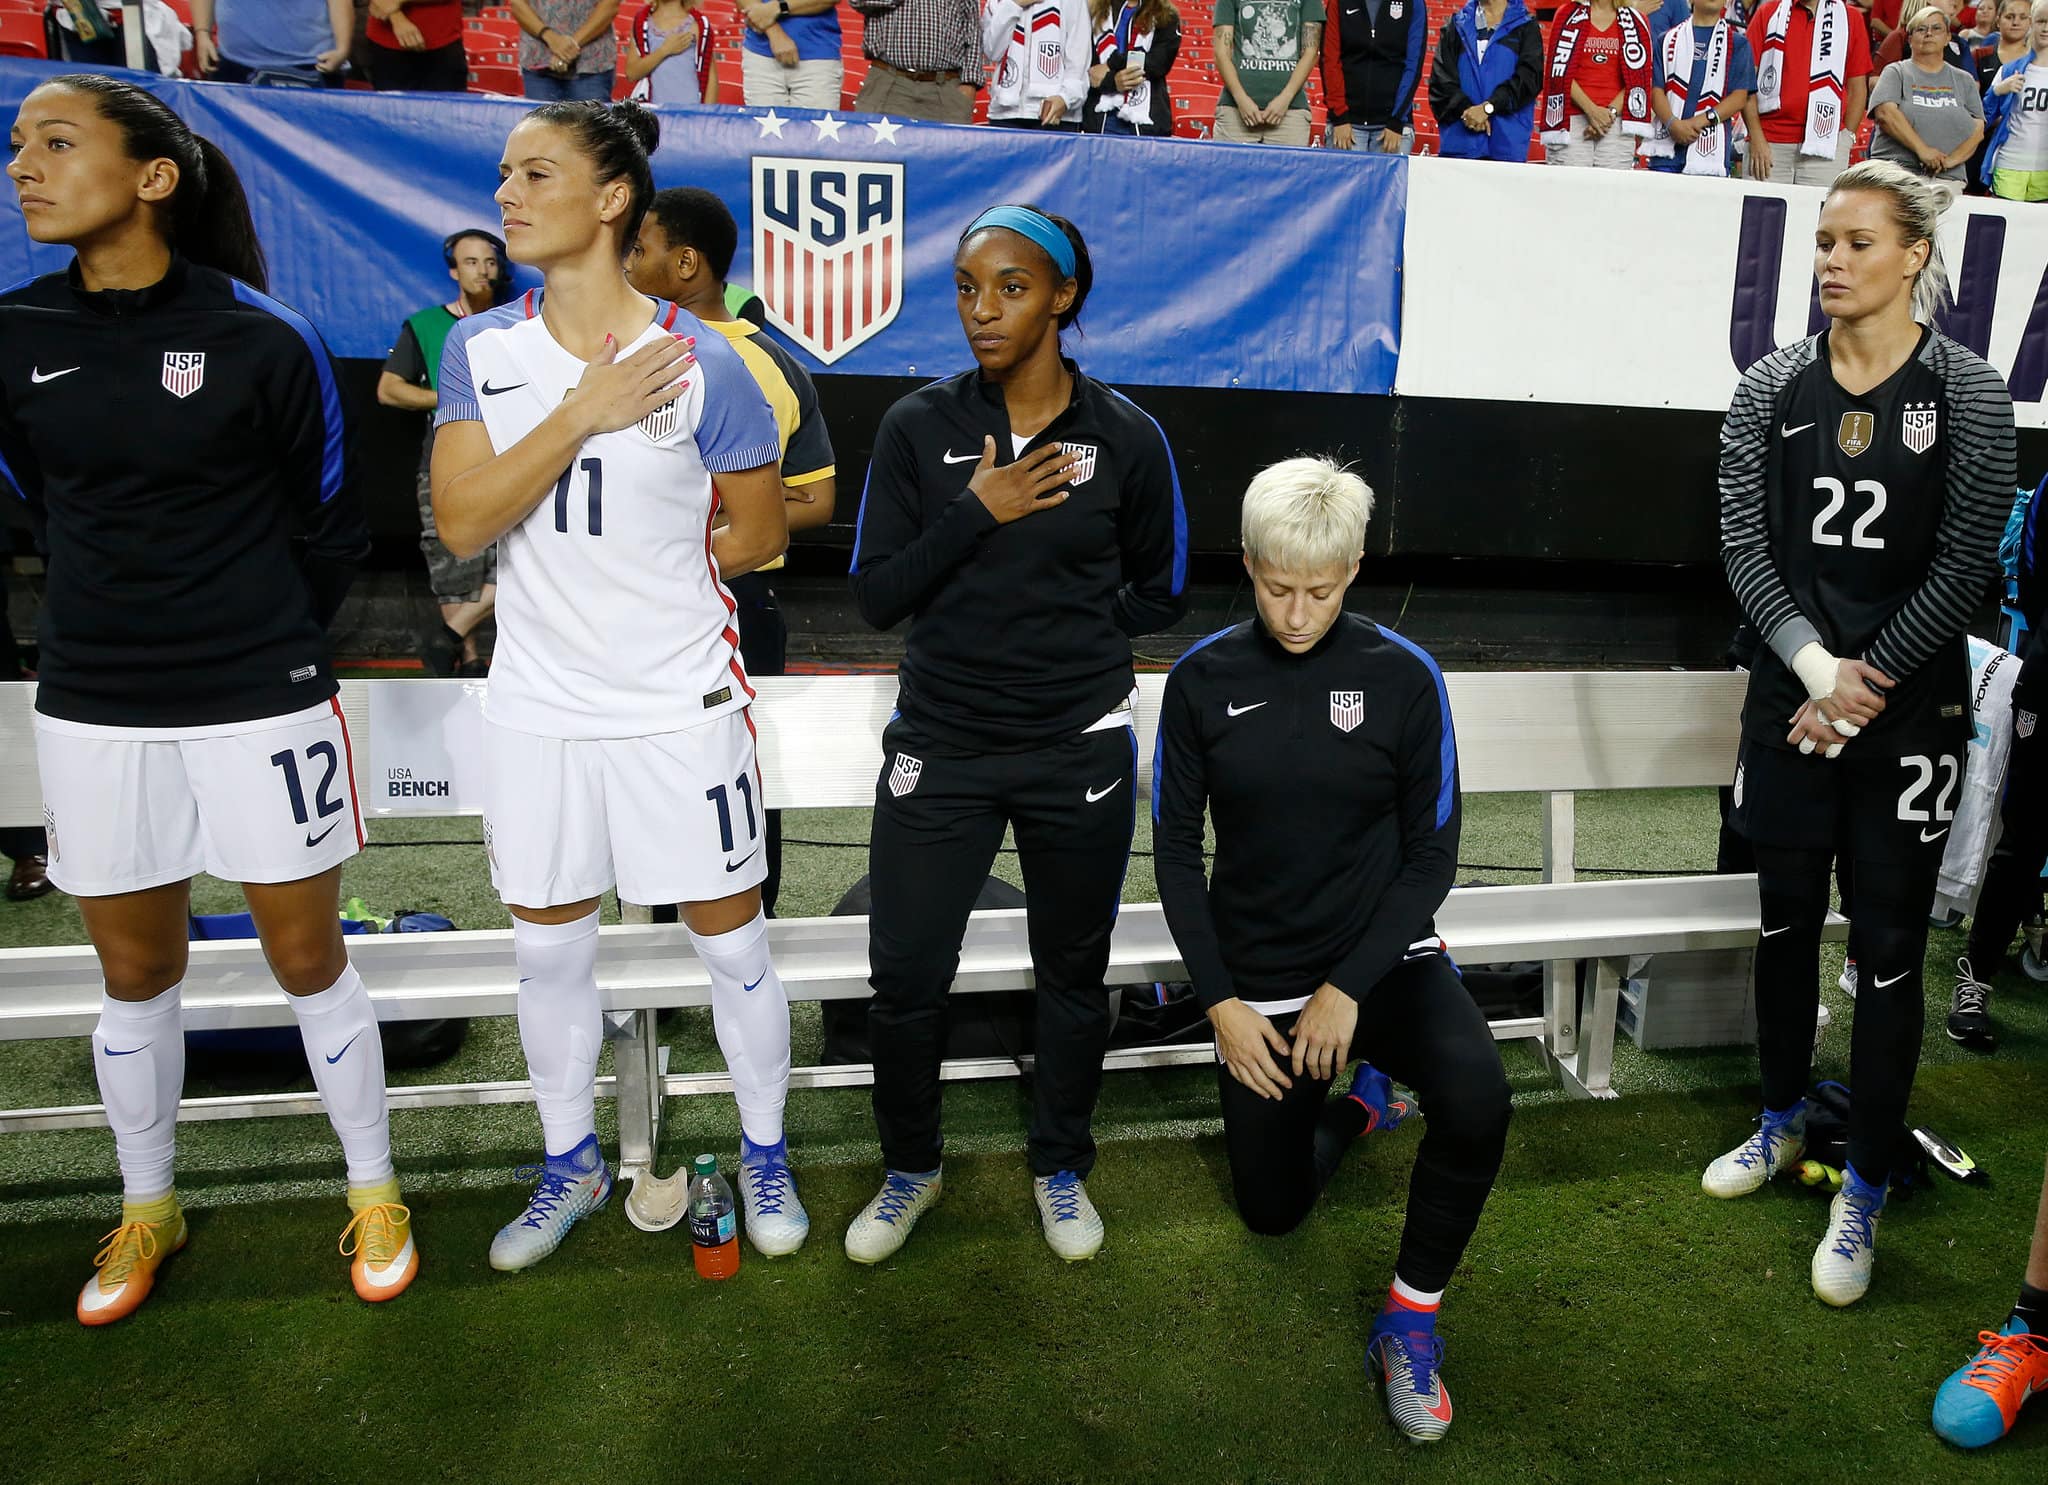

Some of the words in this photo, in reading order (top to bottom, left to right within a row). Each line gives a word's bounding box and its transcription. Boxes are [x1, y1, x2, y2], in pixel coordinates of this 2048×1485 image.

[1819, 11, 1833, 61] TEAM.
[1040, 44, 1061, 57] USA
[1551, 29, 1579, 78] TIRE
[1548, 95, 1563, 110] USA
[2022, 87, 2048, 112] 20
[1816, 104, 1834, 119] USA
[1702, 124, 1715, 137] SA
[763, 168, 893, 247] USA
[166, 354, 203, 371] USA
[1905, 412, 1934, 429] USA
[1812, 476, 1887, 549] 22
[1332, 693, 1361, 709] USA
[2019, 709, 2036, 724] USA
[896, 754, 921, 774] USA
[388, 767, 413, 779] USA
[270, 740, 345, 825] 12
[388, 781, 449, 797] BENCH
[1897, 754, 1959, 822] 22
[705, 771, 757, 853] 11
[693, 1225, 710, 1237] ANI
